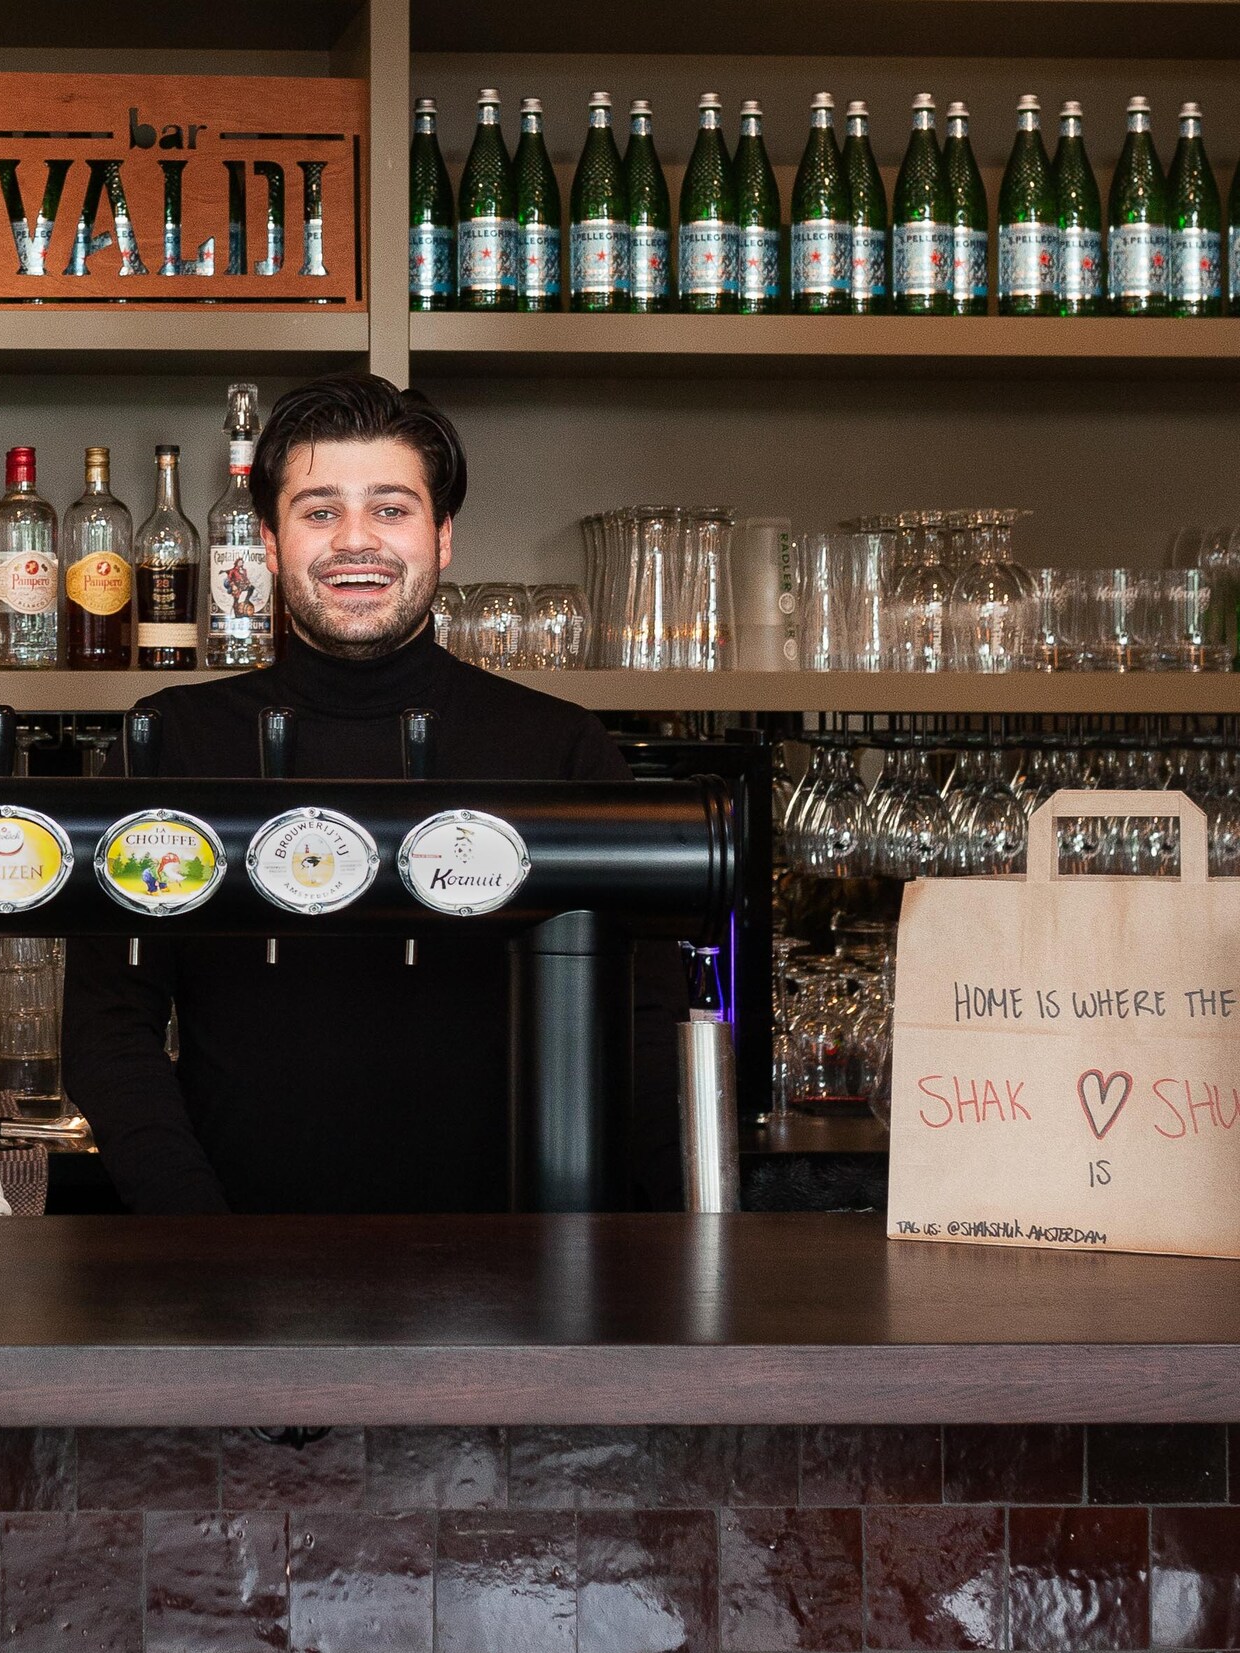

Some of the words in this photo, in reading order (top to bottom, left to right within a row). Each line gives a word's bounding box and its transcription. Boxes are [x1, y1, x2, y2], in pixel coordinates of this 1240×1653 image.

[129, 107, 208, 150] bar
[213, 550, 240, 564] Captain
[242, 549, 266, 563] Morga
[780, 533, 792, 591] RADLER
[12, 573, 50, 590] Pampero
[83, 574, 123, 591] Pampero
[125, 834, 197, 846] CHOUFFE
[430, 868, 503, 889] Kornuit
[284, 881, 343, 899] AMSTERDAM
[954, 981, 1023, 1022] HOME
[1037, 990, 1061, 1019] IS
[1071, 989, 1166, 1020] WHERE
[1183, 988, 1237, 1018] THE
[917, 1075, 1032, 1129] SHAK
[1152, 1078, 1240, 1139] SHU
[1089, 1160, 1111, 1188] IS
[896, 1220, 921, 1235] TAG
